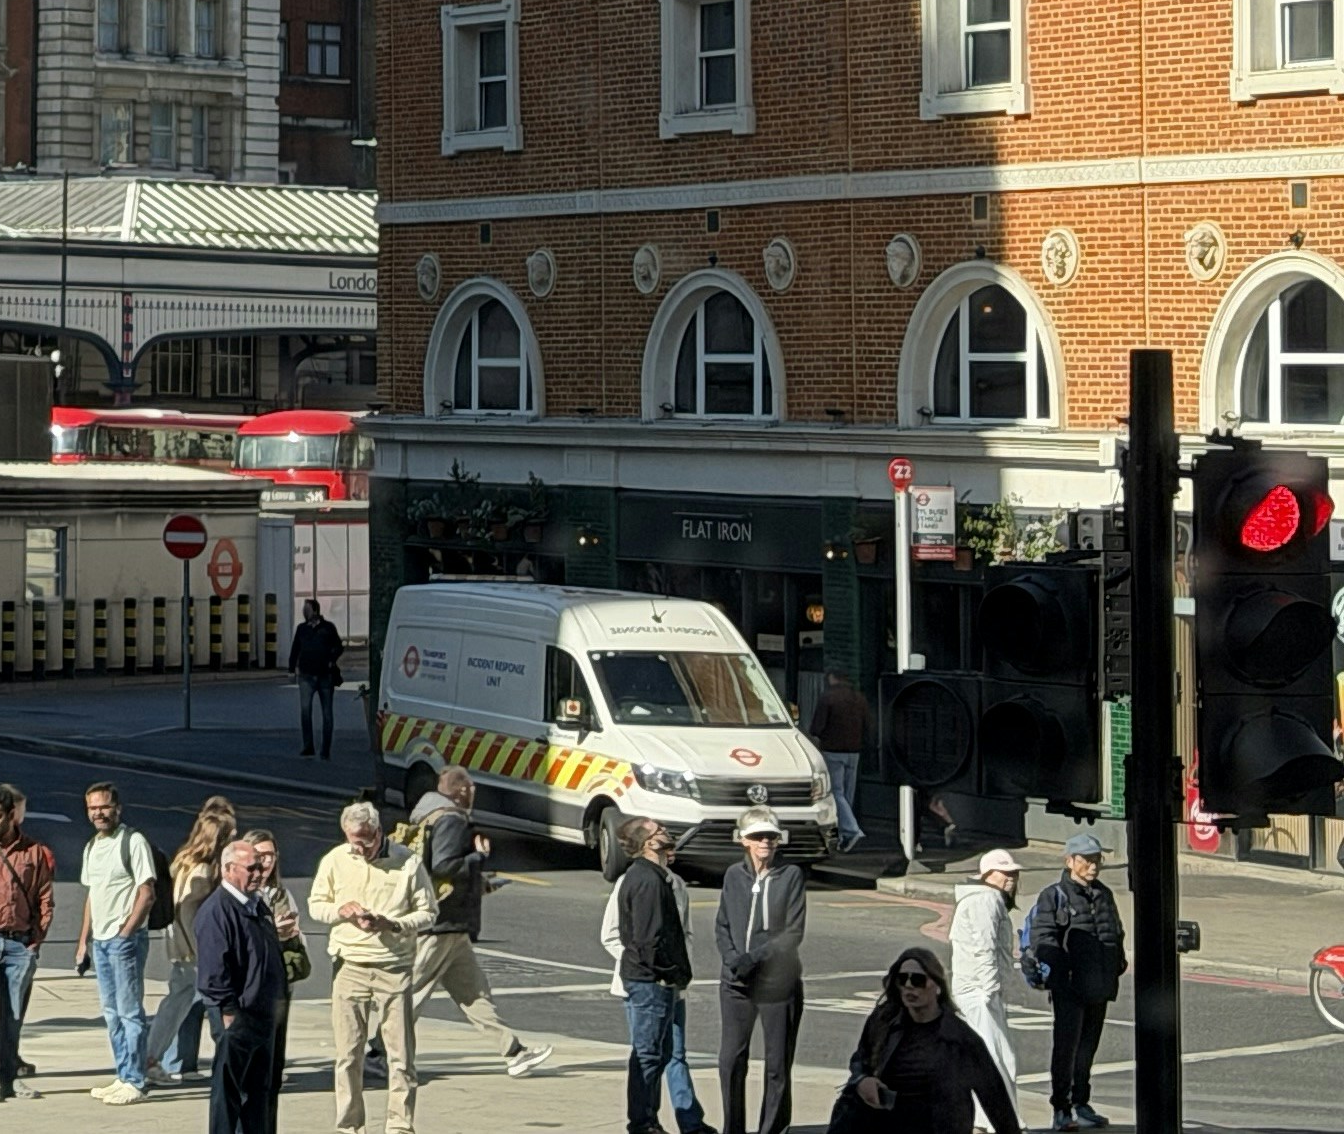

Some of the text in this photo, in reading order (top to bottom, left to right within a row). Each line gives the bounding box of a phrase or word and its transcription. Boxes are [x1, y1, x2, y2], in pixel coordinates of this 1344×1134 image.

[329, 271, 377, 291] Londo
[682, 519, 752, 542] FLAT IRON
